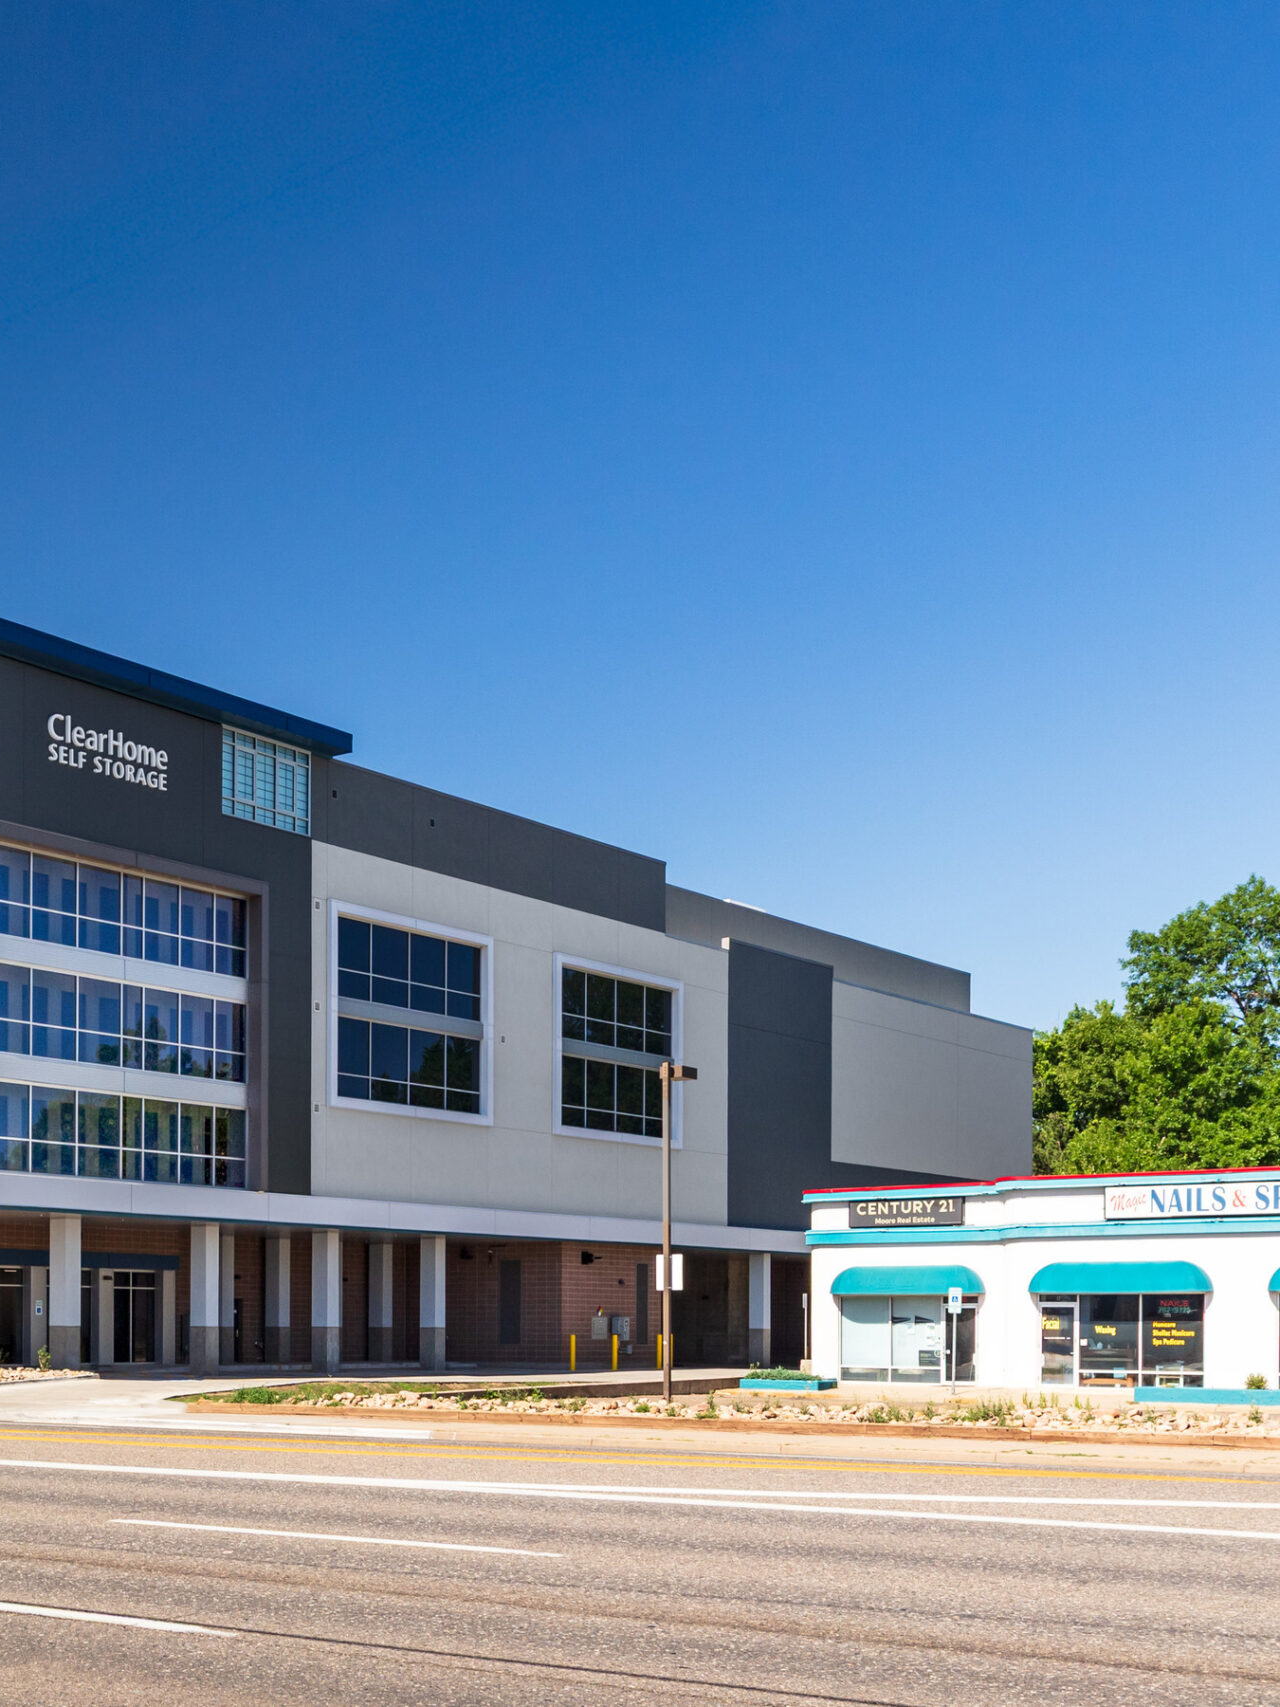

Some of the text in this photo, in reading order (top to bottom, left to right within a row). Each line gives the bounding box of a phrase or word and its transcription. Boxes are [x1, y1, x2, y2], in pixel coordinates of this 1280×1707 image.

[47, 713, 168, 770] ClearHome
[48, 743, 168, 791] SELF STORAGE
[856, 1199, 954, 1216] CENTURY 21
[1110, 1193, 1147, 1213] Magic
[1150, 1187, 1226, 1213] NAILS
[1232, 1189, 1246, 1208] &
[897, 1216, 911, 1224] Real
[913, 1216, 936, 1224] Estate
[1094, 1325, 1117, 1336] Waxing
